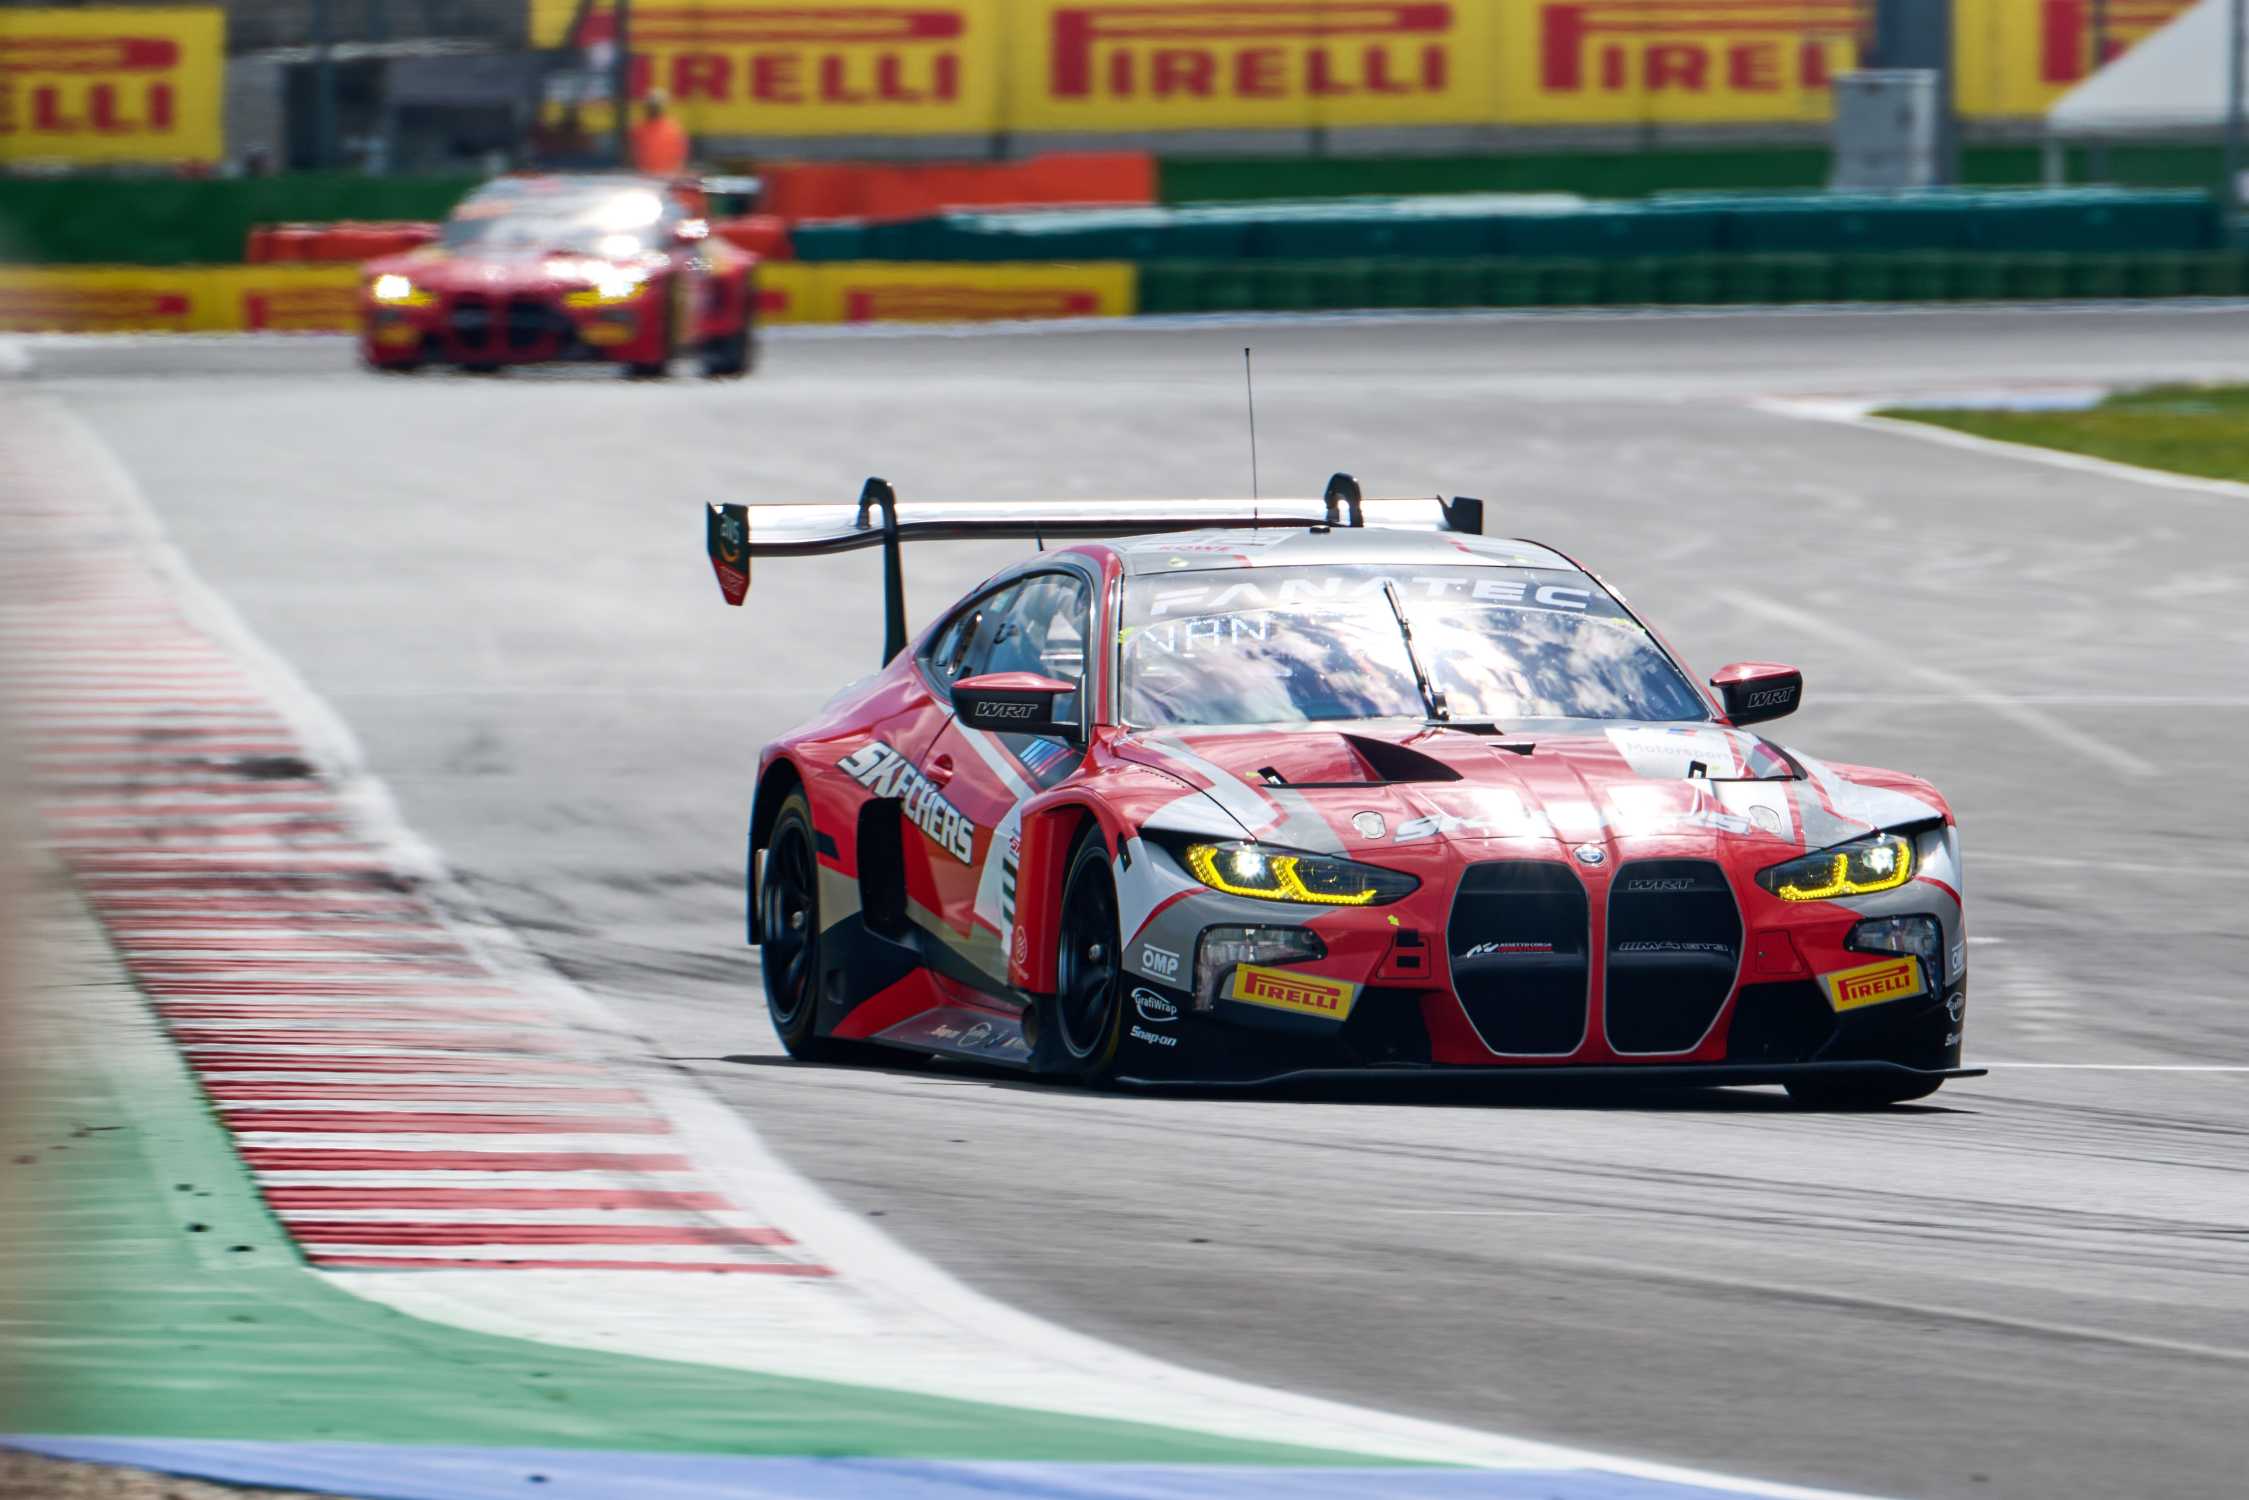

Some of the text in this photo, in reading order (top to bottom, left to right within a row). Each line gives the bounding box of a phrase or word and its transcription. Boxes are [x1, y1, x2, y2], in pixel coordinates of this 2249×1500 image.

[1050, 2, 1455, 99] PIRELLI
[1540, 0, 1876, 92] PIREL
[1149, 575, 1591, 617] FANATEC
[974, 701, 1039, 719] WRT
[1746, 685, 1796, 708] WRT
[836, 740, 976, 868] SKECHERS
[1142, 949, 1179, 977] OMP
[1244, 970, 1342, 1010] PIRELLI
[1838, 964, 1911, 1002] PIRELLI
[1135, 993, 1178, 1016] GrafiWrap
[1129, 1024, 1177, 1047] Snap-on
